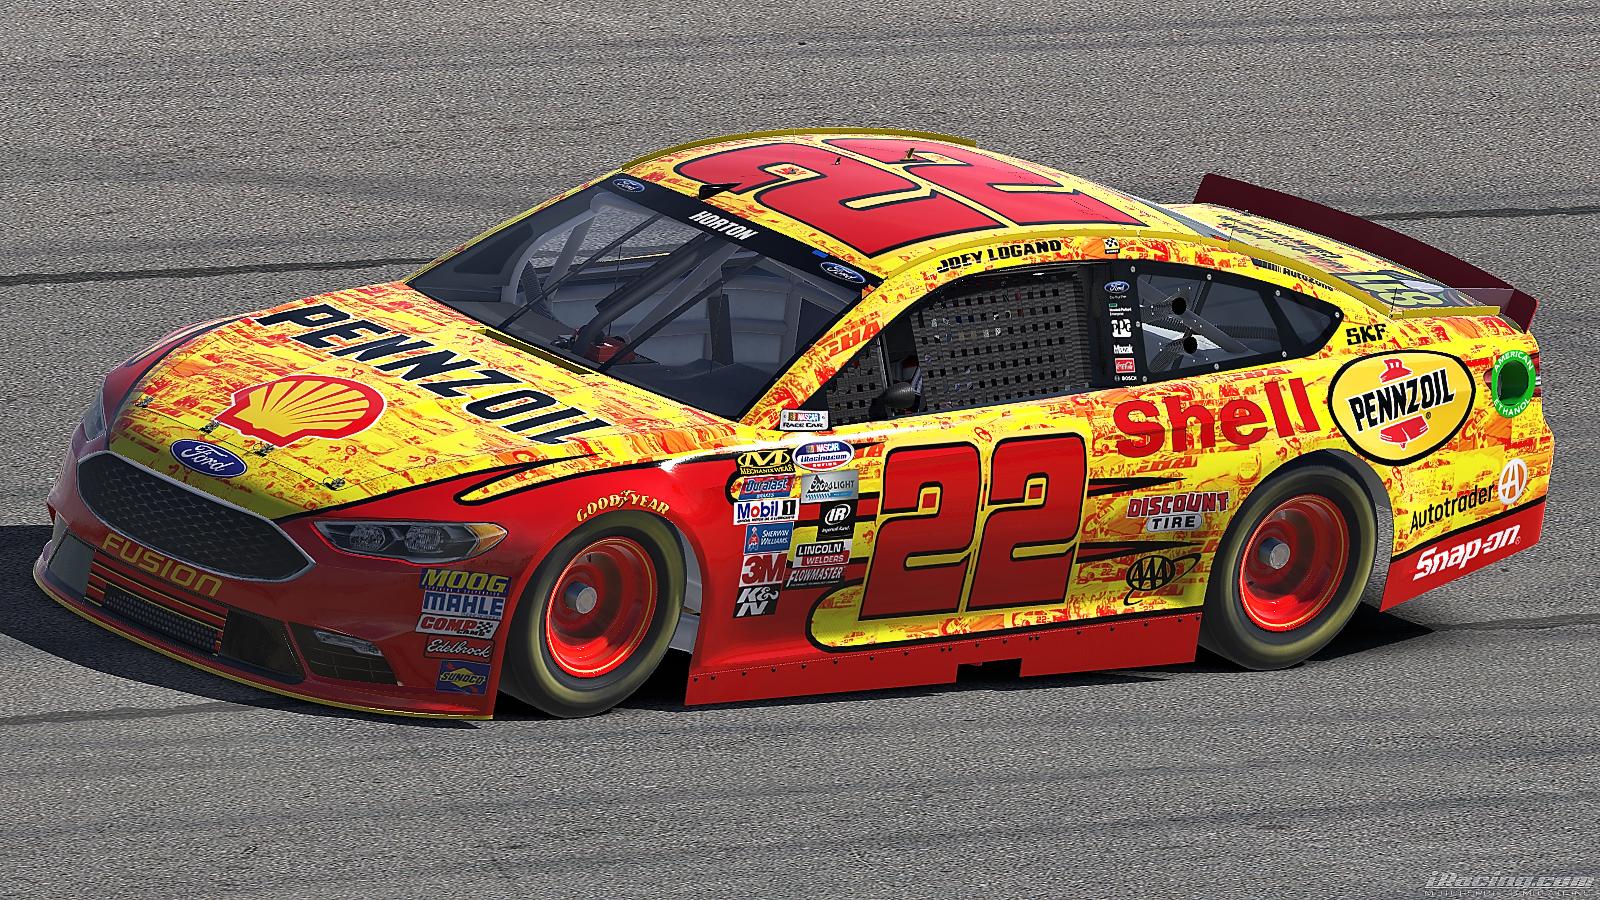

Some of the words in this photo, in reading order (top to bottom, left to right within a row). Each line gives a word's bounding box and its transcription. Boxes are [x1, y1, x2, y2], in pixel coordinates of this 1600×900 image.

[616, 179, 641, 192] Ford
[688, 211, 759, 240] HORTON
[937, 251, 982, 273] JOEY
[988, 240, 1062, 259] LOGANO
[825, 263, 860, 282] Ford
[1283, 267, 1334, 291] AutoZone
[1108, 283, 1126, 292] Ford
[1345, 323, 1387, 345] SKF
[1494, 350, 1533, 373] AMERICAN
[252, 303, 611, 444] PENNZOIL
[1347, 369, 1455, 432] PENNZOIL
[1494, 398, 1531, 417] ETHANOL
[796, 413, 820, 421] NASCAR
[1113, 378, 1321, 457] Shell
[178, 441, 237, 476] Ford
[816, 443, 840, 453] NASCAR
[745, 478, 788, 493] Duralast
[834, 480, 855, 490] LIGHT
[737, 501, 779, 520] Mobil
[1127, 491, 1229, 518] DISCOUNT
[1409, 483, 1494, 533] Autotrader
[858, 432, 1088, 622] 22
[1152, 515, 1196, 530] TIRE
[761, 529, 789, 539] SHERWIN
[798, 543, 842, 556] LINCOLN
[806, 554, 845, 565] WELDERS
[1413, 524, 1521, 581] Snap-on
[102, 532, 223, 597] FUSION
[741, 554, 788, 585] 3M
[1129, 556, 1174, 591] AAA
[421, 569, 509, 593] MOOG
[787, 567, 844, 587] FLOWMASTER
[423, 592, 504, 616] MAHLE
[420, 616, 478, 632] COMP
[426, 638, 491, 658] Edelbrock
[440, 671, 485, 685] SUNOCO
